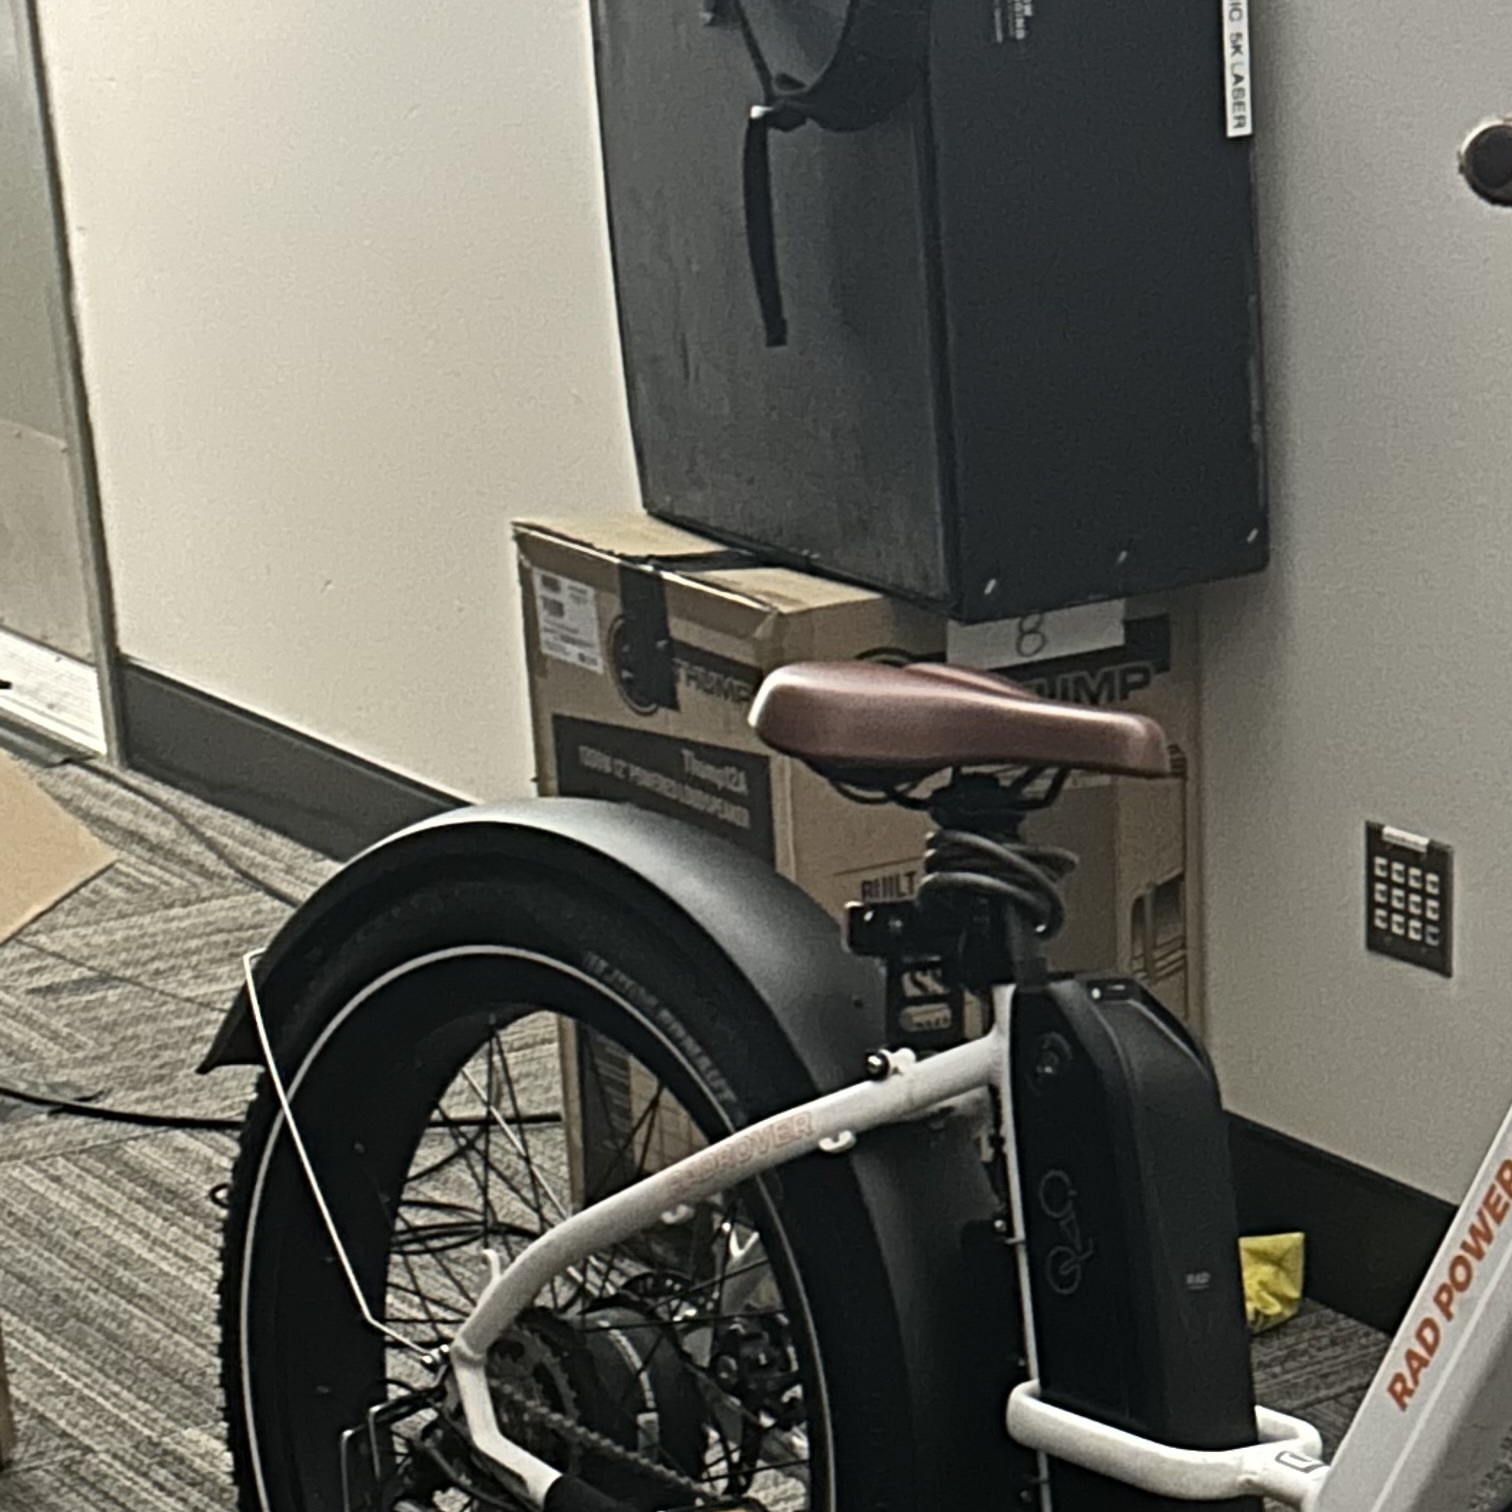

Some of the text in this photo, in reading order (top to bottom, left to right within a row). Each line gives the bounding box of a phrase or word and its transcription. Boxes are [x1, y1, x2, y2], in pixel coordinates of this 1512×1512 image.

[1229, 0, 1247, 130] IC 5K LASER
[1016, 613, 1047, 657] 8
[667, 1110, 815, 1194] RADROVER
[1386, 1317, 1441, 1412] RAD
